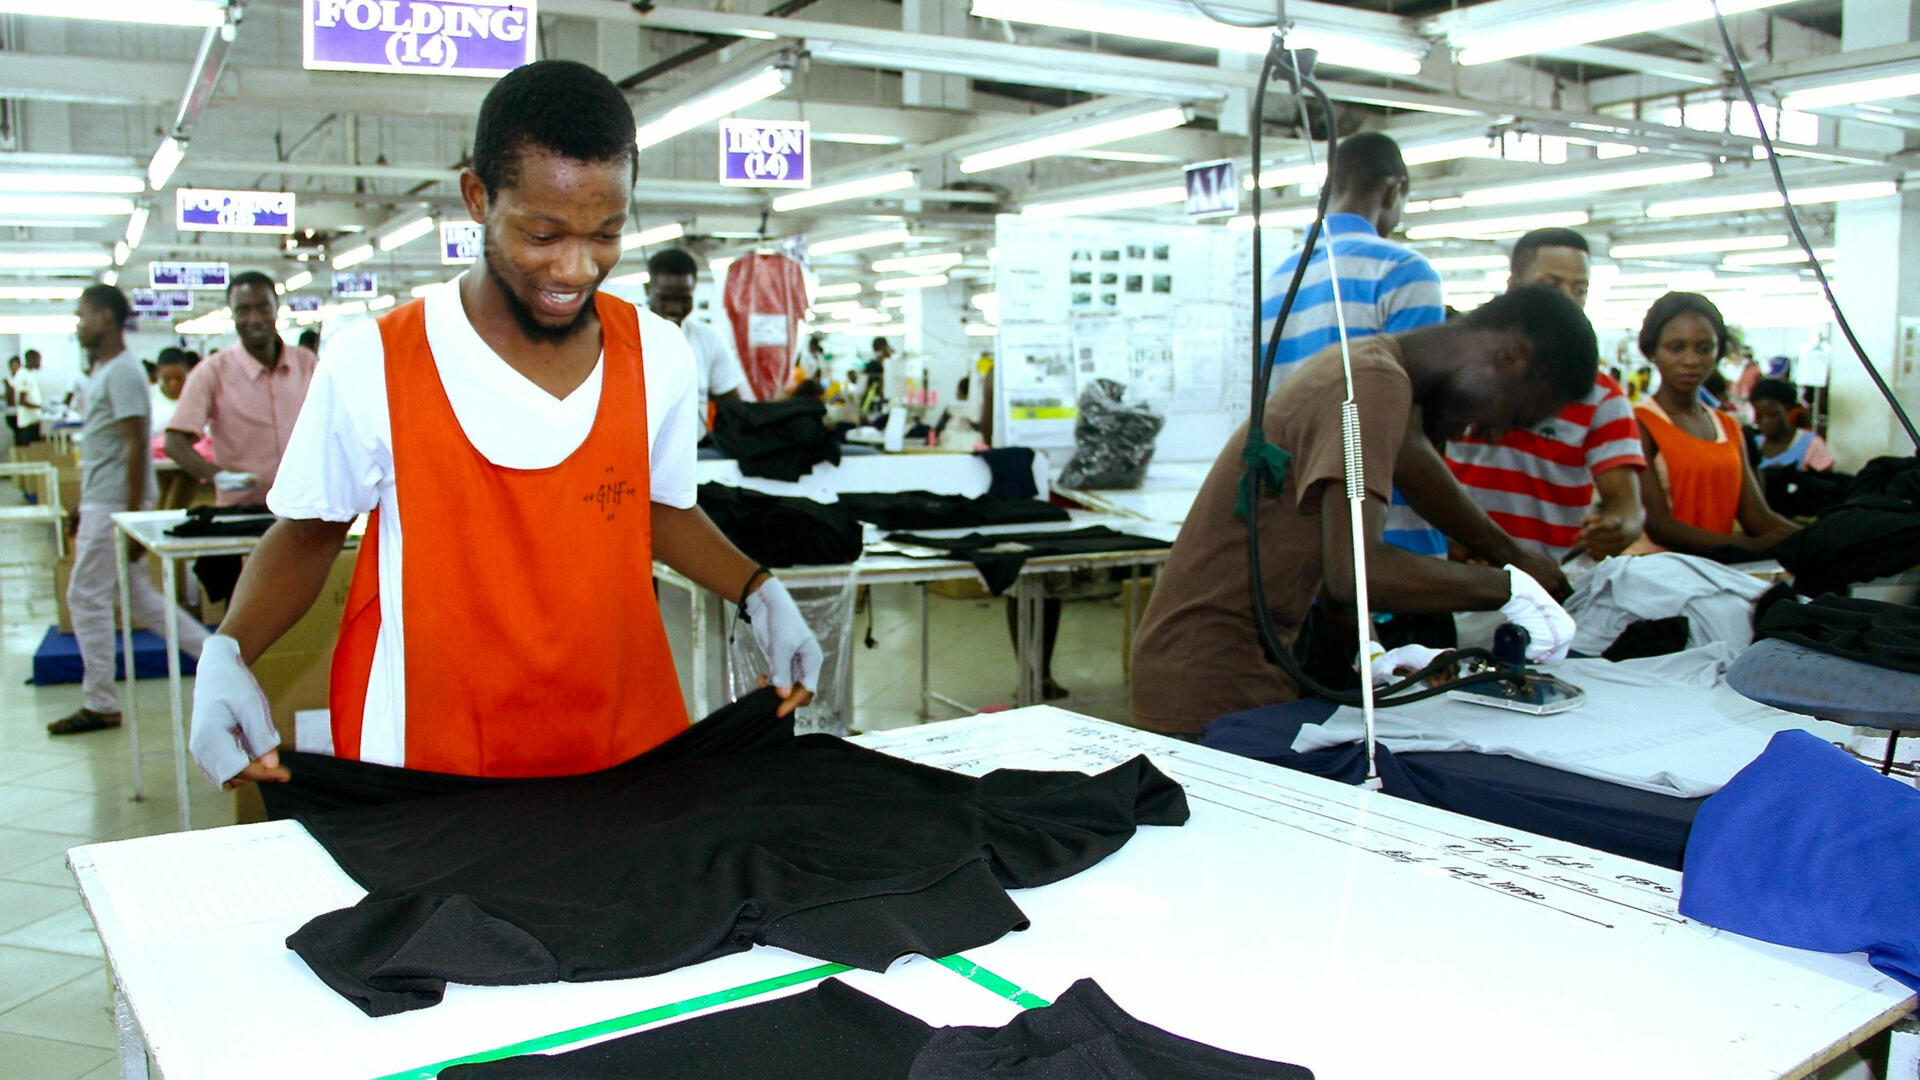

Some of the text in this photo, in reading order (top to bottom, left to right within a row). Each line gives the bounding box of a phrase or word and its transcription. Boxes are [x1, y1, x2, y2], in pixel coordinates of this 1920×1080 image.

[315, 0, 525, 41] FOLDING
[385, 32, 458, 68] (14)
[728, 128, 801, 155] IRON
[744, 152, 788, 180] (14)
